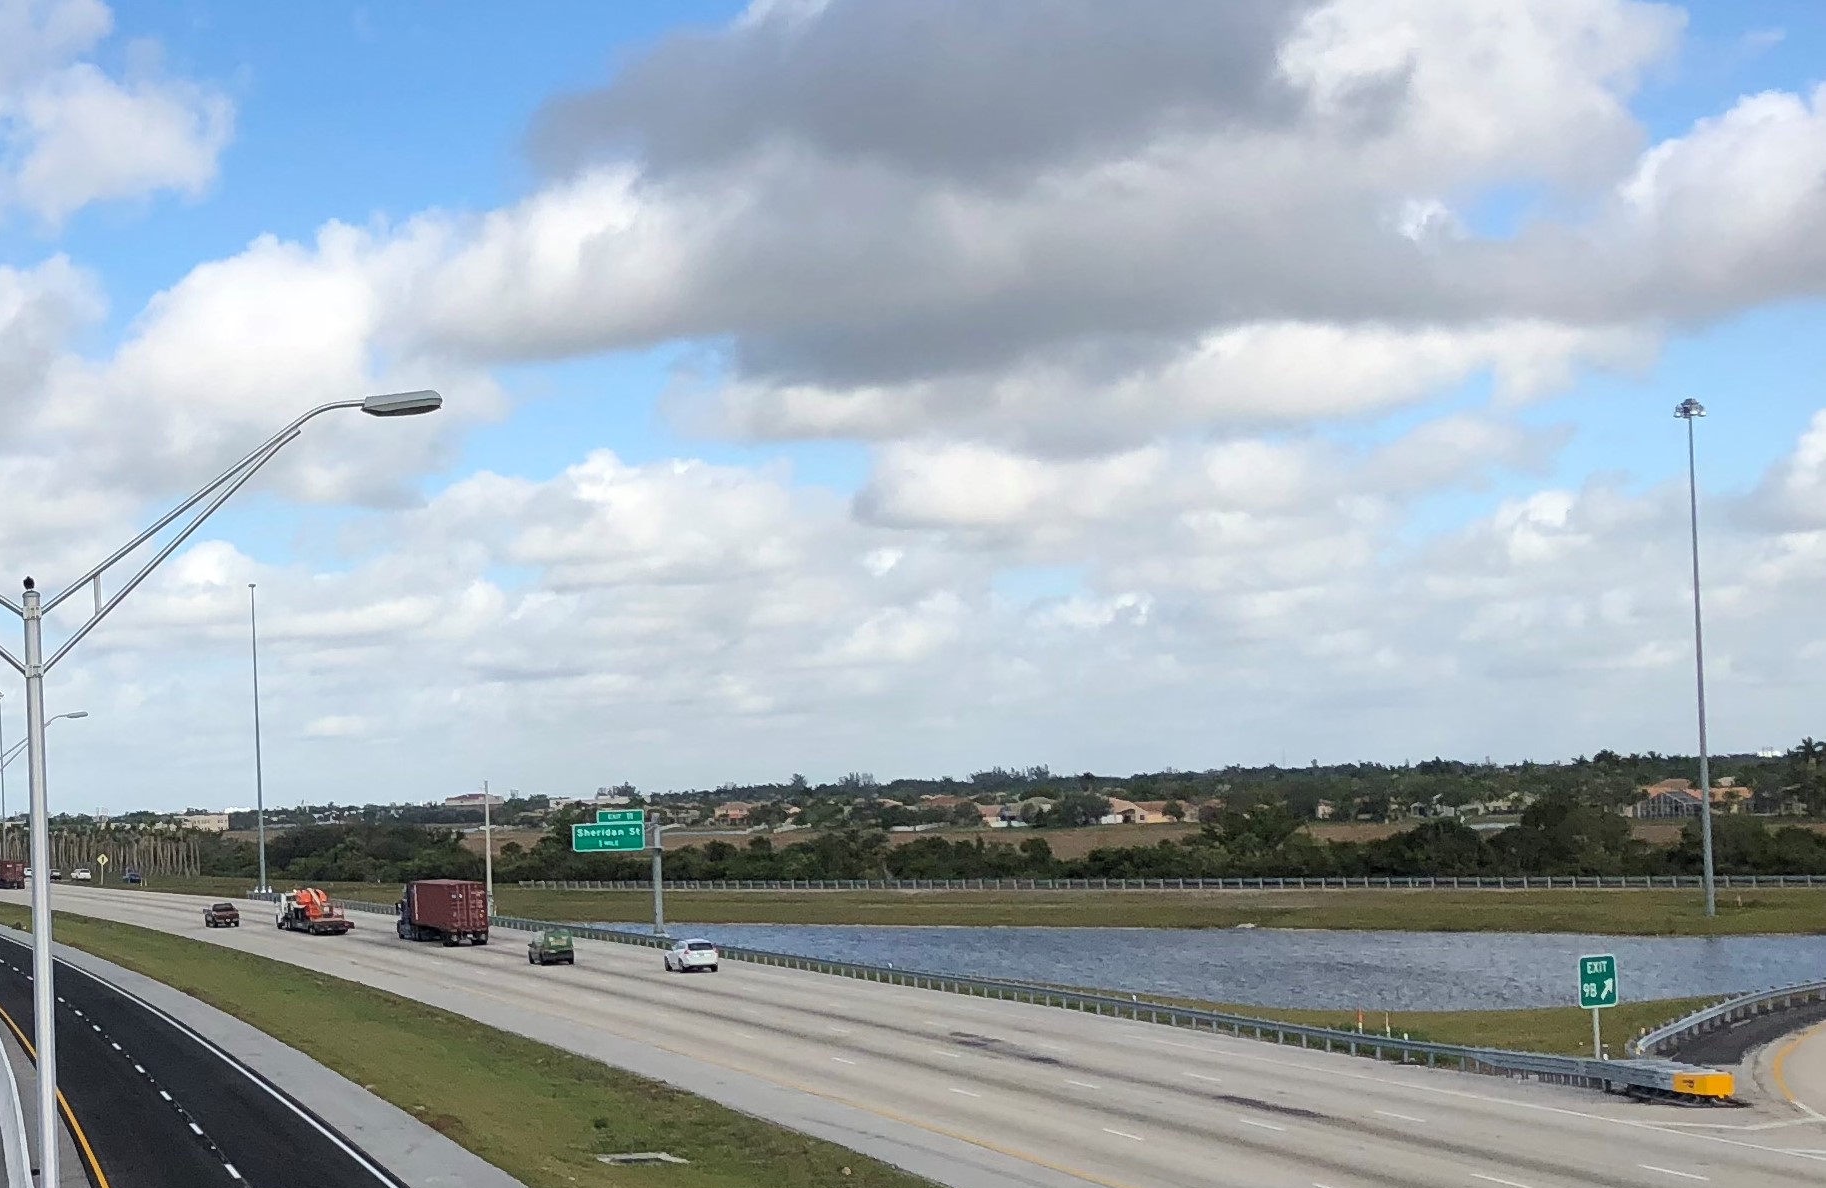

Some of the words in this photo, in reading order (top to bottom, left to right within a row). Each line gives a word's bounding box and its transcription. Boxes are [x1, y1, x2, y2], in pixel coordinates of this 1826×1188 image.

[577, 829, 624, 837] Sheridan
[629, 828, 640, 836] St
[1586, 960, 1607, 974] EXIT
[1583, 983, 1597, 997] 9B
